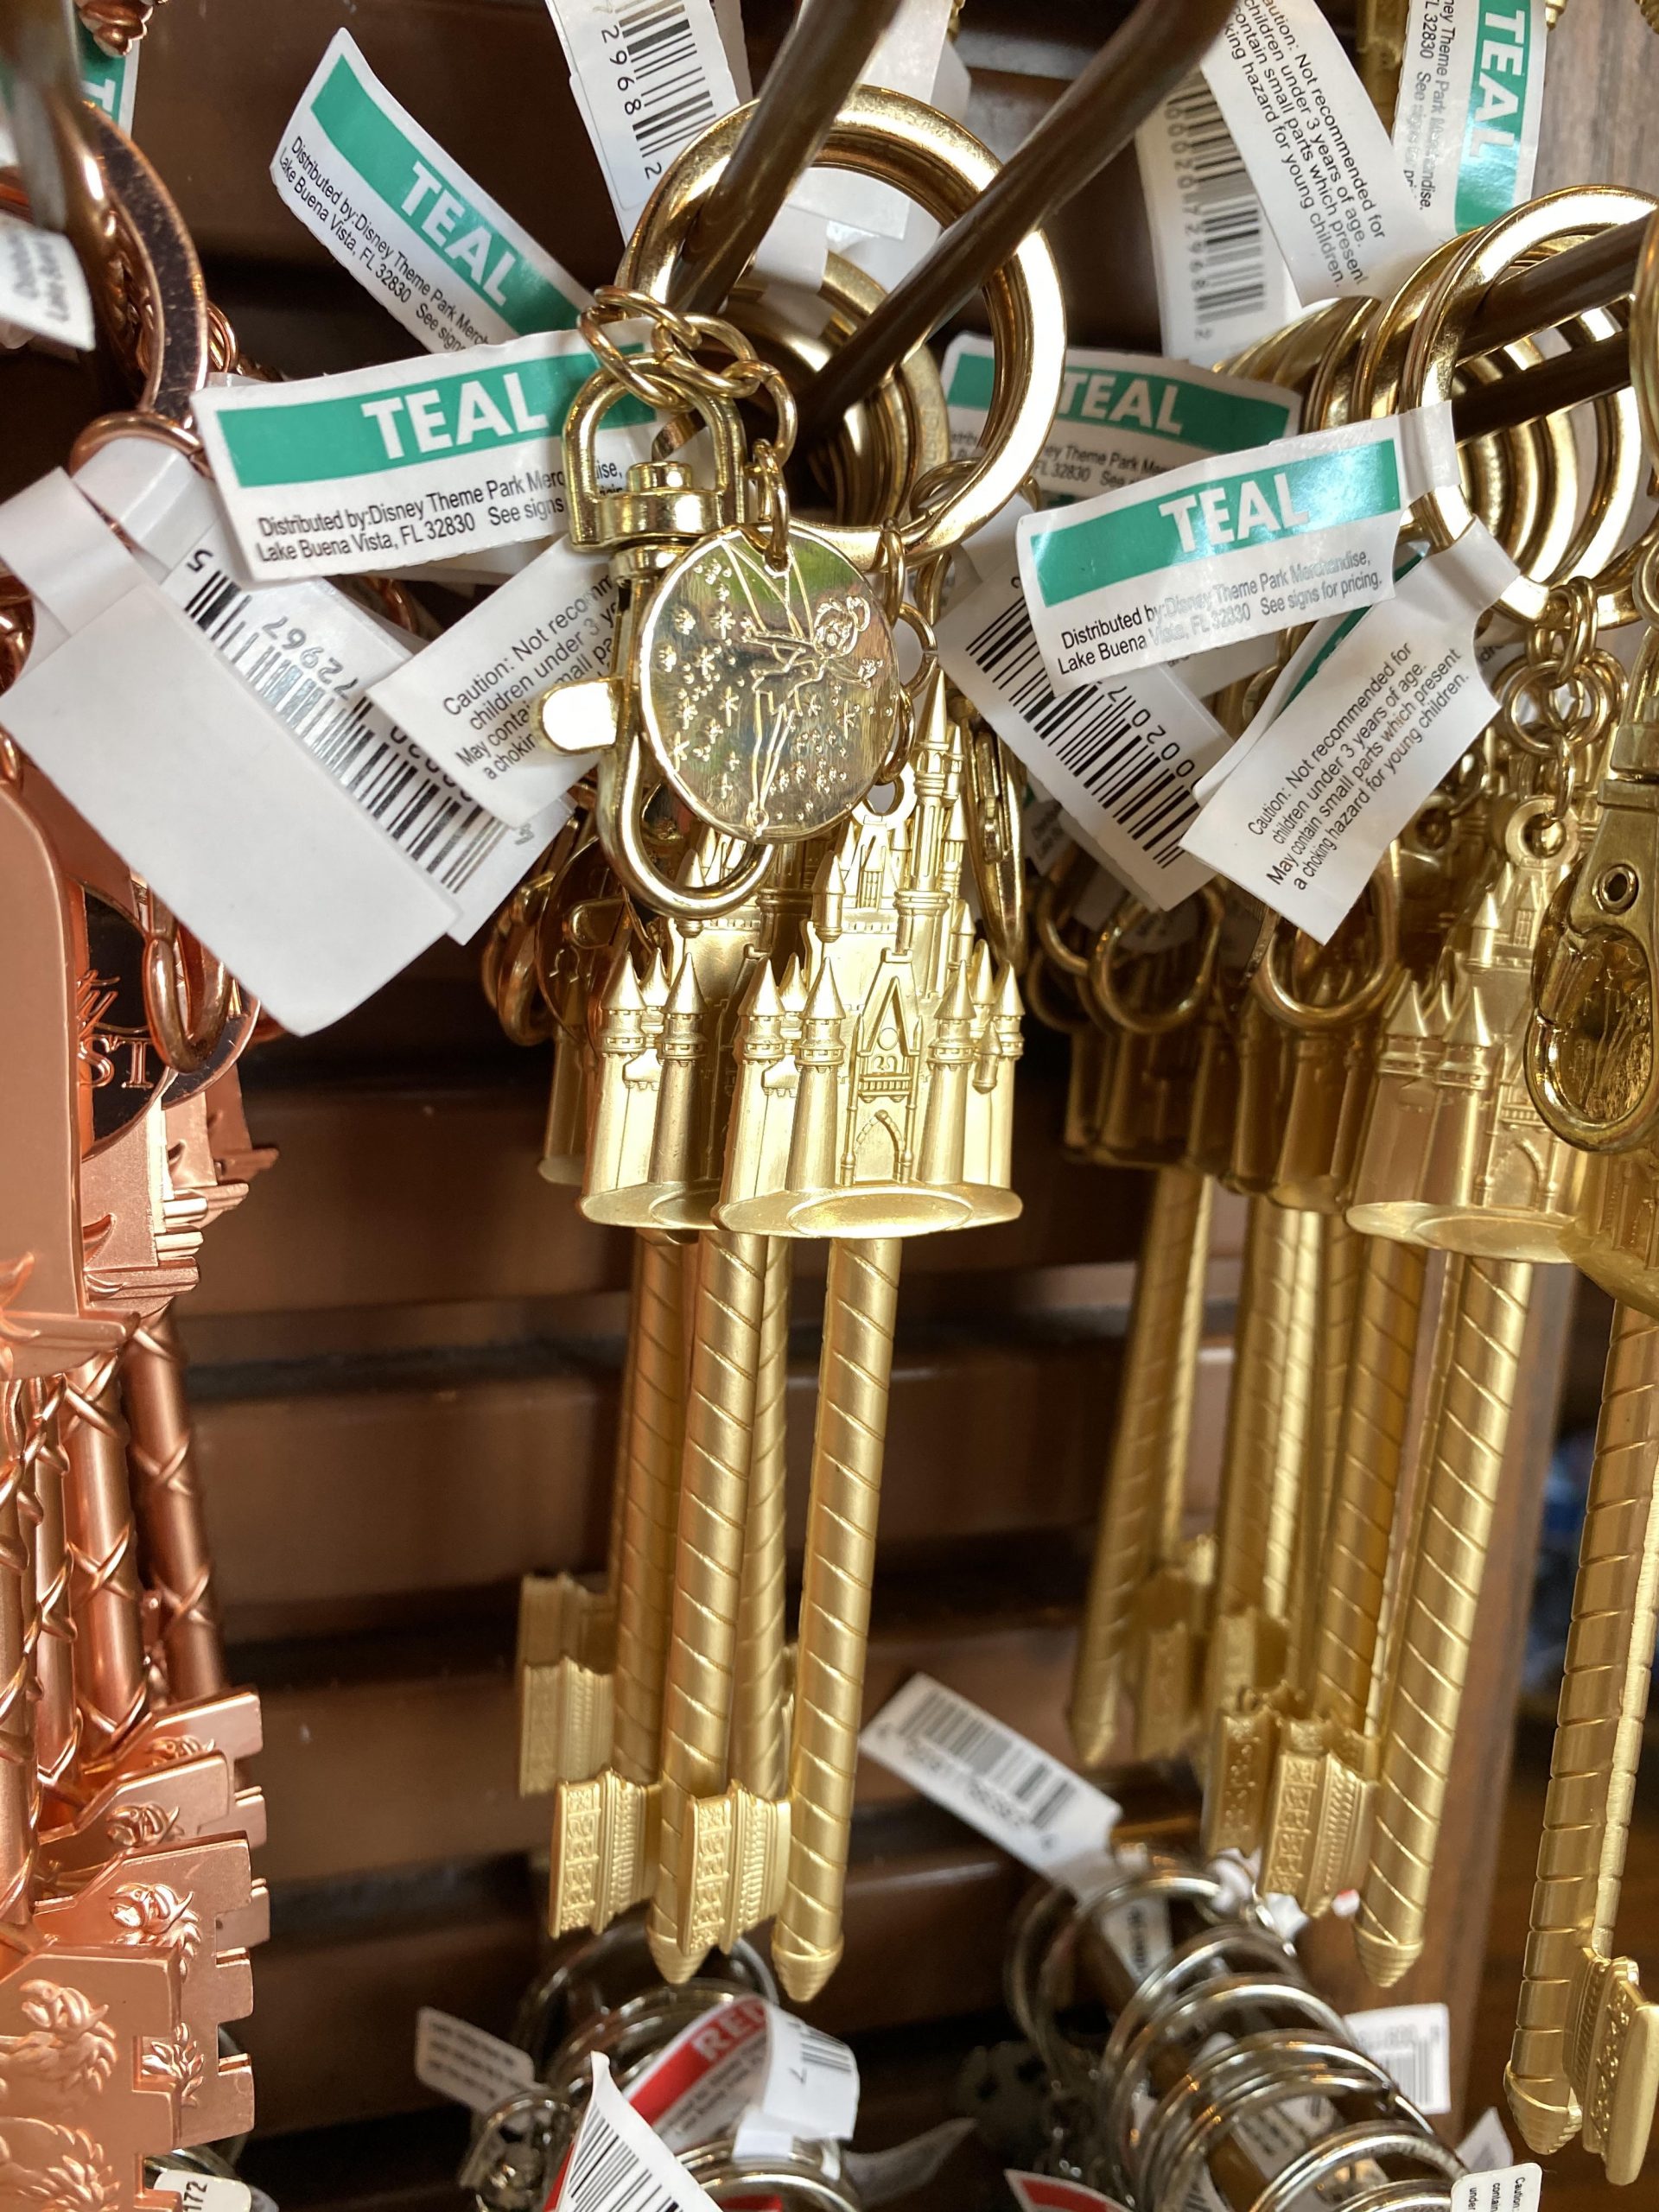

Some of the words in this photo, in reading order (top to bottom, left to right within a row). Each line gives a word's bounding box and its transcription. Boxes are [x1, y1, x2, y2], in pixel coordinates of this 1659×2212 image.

[1244, 0, 1284, 61] children
[1420, 13, 1438, 60] 32830
[1436, 27, 1455, 76] Theme
[1262, 0, 1299, 51] aution:
[1294, 53, 1318, 86] Not
[1311, 88, 1376, 211] recommended
[1369, 213, 1385, 238] for
[1281, 64, 1311, 113] under
[1307, 117, 1320, 130] 3
[1431, 79, 1450, 114] Park
[1469, 10, 1525, 159] TEAL
[1224, 23, 1246, 60] king
[1242, 61, 1280, 123] hazard
[1272, 125, 1290, 149] for
[1281, 153, 1314, 210] young
[1309, 212, 1344, 288] children.
[1264, 67, 1294, 113] small
[1284, 118, 1313, 162] parts
[1309, 164, 1338, 216] which
[1310, 133, 1341, 183] years
[291, 136, 343, 205] Distributed
[394, 251, 432, 296] Theme
[430, 289, 456, 321] Park
[401, 160, 516, 307] TEAL
[1337, 187, 1354, 203] of
[1345, 207, 1365, 248] age.
[279, 147, 296, 182] Lake
[294, 176, 329, 222] Buena
[330, 214, 357, 256] Vista,
[359, 247, 376, 271] FL
[375, 264, 411, 303] 32830
[416, 303, 439, 332] See
[438, 327, 467, 352] sign
[360, 372, 550, 460] TEAL
[1057, 372, 1184, 435] TEAL
[1066, 443, 1106, 466] Theme
[1109, 452, 1137, 471] Park
[257, 543, 297, 562] Lake
[299, 539, 353, 558] Buena
[351, 531, 398, 553] Vista,
[400, 523, 423, 545] FL
[424, 512, 475, 540] 32830
[488, 505, 521, 526] See
[524, 497, 564, 521] signs
[258, 510, 344, 537] Distributed
[426, 486, 484, 514] Theme
[486, 474, 524, 499] Park
[1158, 472, 1310, 554] TEAL
[1058, 651, 1096, 675] Lake
[1097, 634, 1147, 660] Buena
[1260, 595, 1285, 616] See
[1287, 586, 1319, 610] signs
[1321, 581, 1338, 599] for
[1340, 569, 1382, 599] pricing.
[1061, 607, 1142, 649] Distributed
[1213, 578, 1258, 602] Theme
[1259, 567, 1288, 592] Park
[443, 657, 515, 716] Caution:
[512, 628, 550, 662] Not
[454, 741, 490, 767] May
[487, 701, 530, 746] conta
[555, 653, 593, 684] mall
[470, 676, 535, 730] children
[534, 631, 584, 678] under
[583, 617, 601, 636] 3
[483, 766, 497, 780] a
[1248, 787, 1291, 836] Caution:
[1286, 759, 1314, 789] Not
[1311, 662, 1395, 762] recommended
[1390, 642, 1412, 667] for
[1266, 853, 1300, 885] May
[1291, 816, 1323, 855] contain
[1319, 775, 1354, 817] small
[1351, 741, 1383, 782] parts
[1381, 701, 1416, 743] which
[1414, 648, 1462, 706] present
[1273, 799, 1310, 844] children
[1306, 756, 1344, 800] under
[1340, 743, 1355, 758] 3
[1352, 706, 1388, 750] years
[1385, 686, 1401, 708] of
[1398, 663, 1427, 693] age.
[1294, 877, 1308, 890] a
[1302, 836, 1338, 877] choking
[1325, 787, 1370, 840] hazard
[1365, 768, 1386, 791] for
[1384, 727, 1423, 775] young
[1418, 673, 1469, 728] children.
[1468, 2187, 1479, 2210] under
